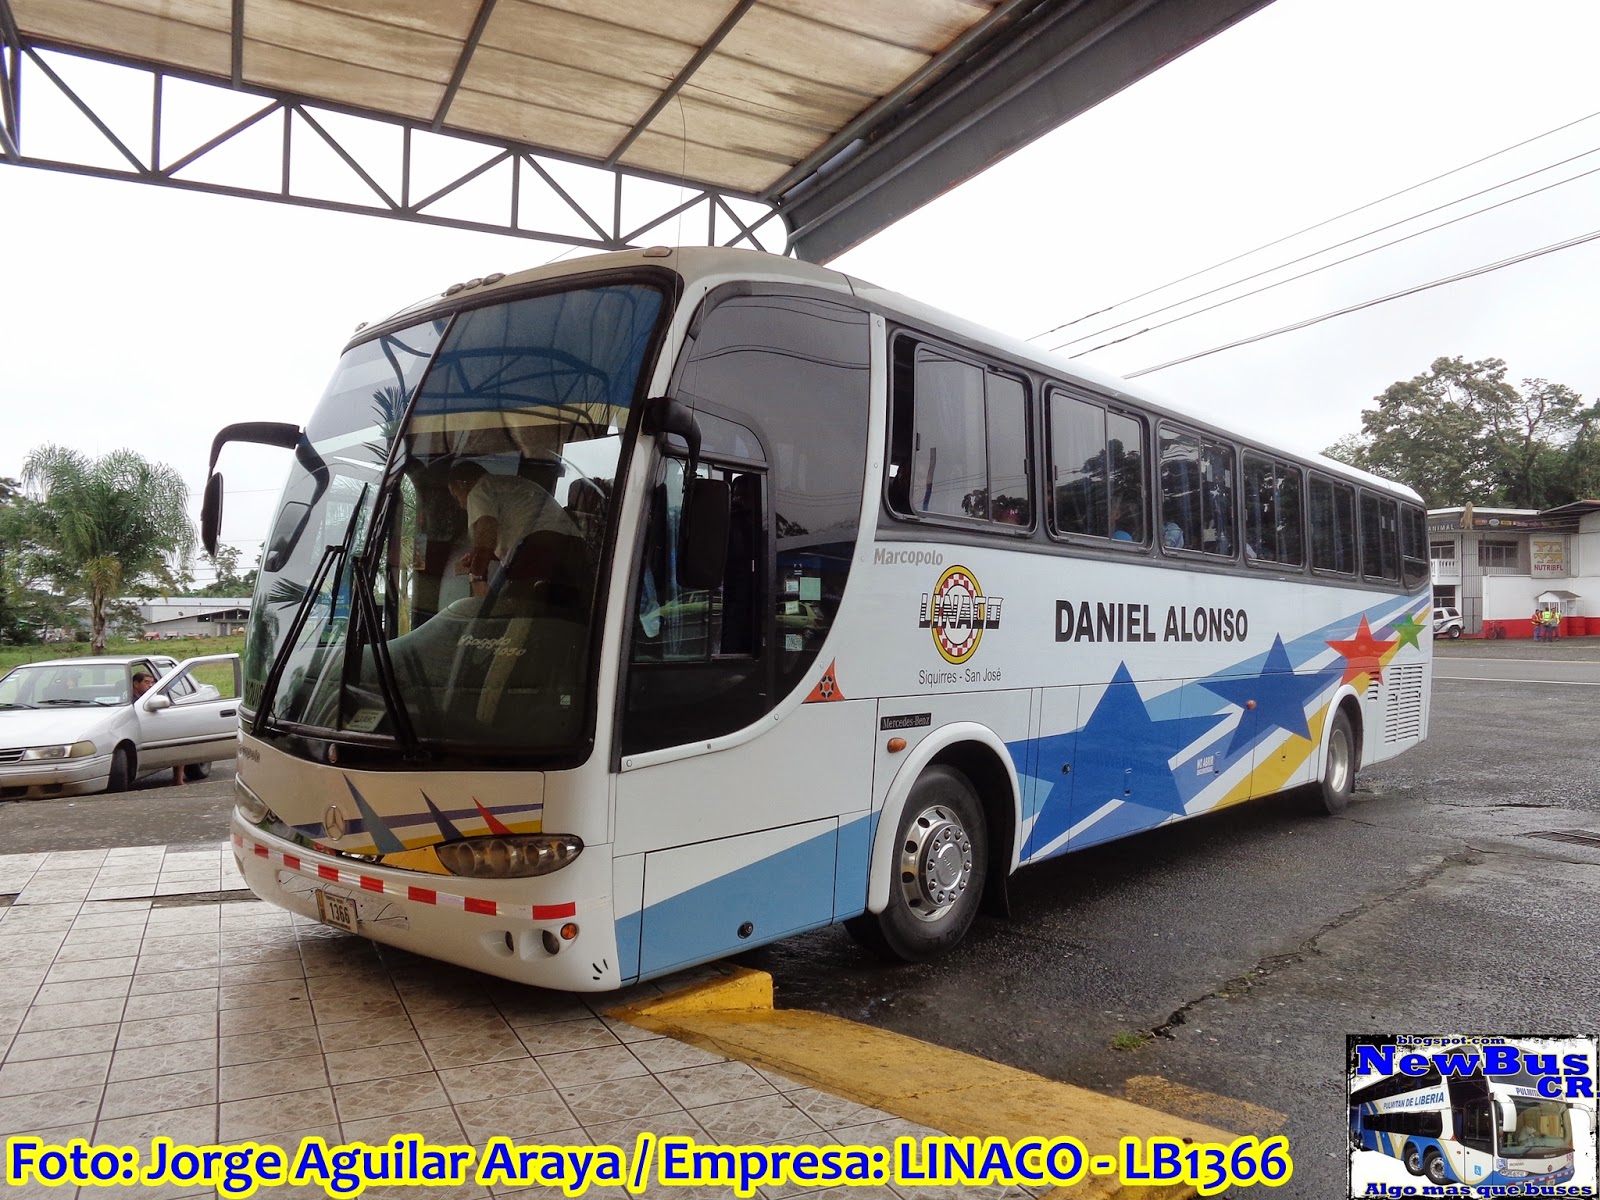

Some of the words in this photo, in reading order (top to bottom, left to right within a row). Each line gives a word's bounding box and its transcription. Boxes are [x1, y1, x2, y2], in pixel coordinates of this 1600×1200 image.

[1427, 524, 1455, 532] ANIMAL
[874, 548, 943, 566] Marcopolo
[1055, 599, 1156, 642] DANIEL
[1163, 605, 1248, 642] ALONSO
[918, 669, 957, 688] Siquirres
[965, 669, 981, 682] San
[982, 668, 1001, 681] José
[882, 716, 930, 728] Mercedes-Benz
[329, 902, 350, 924] 1366
